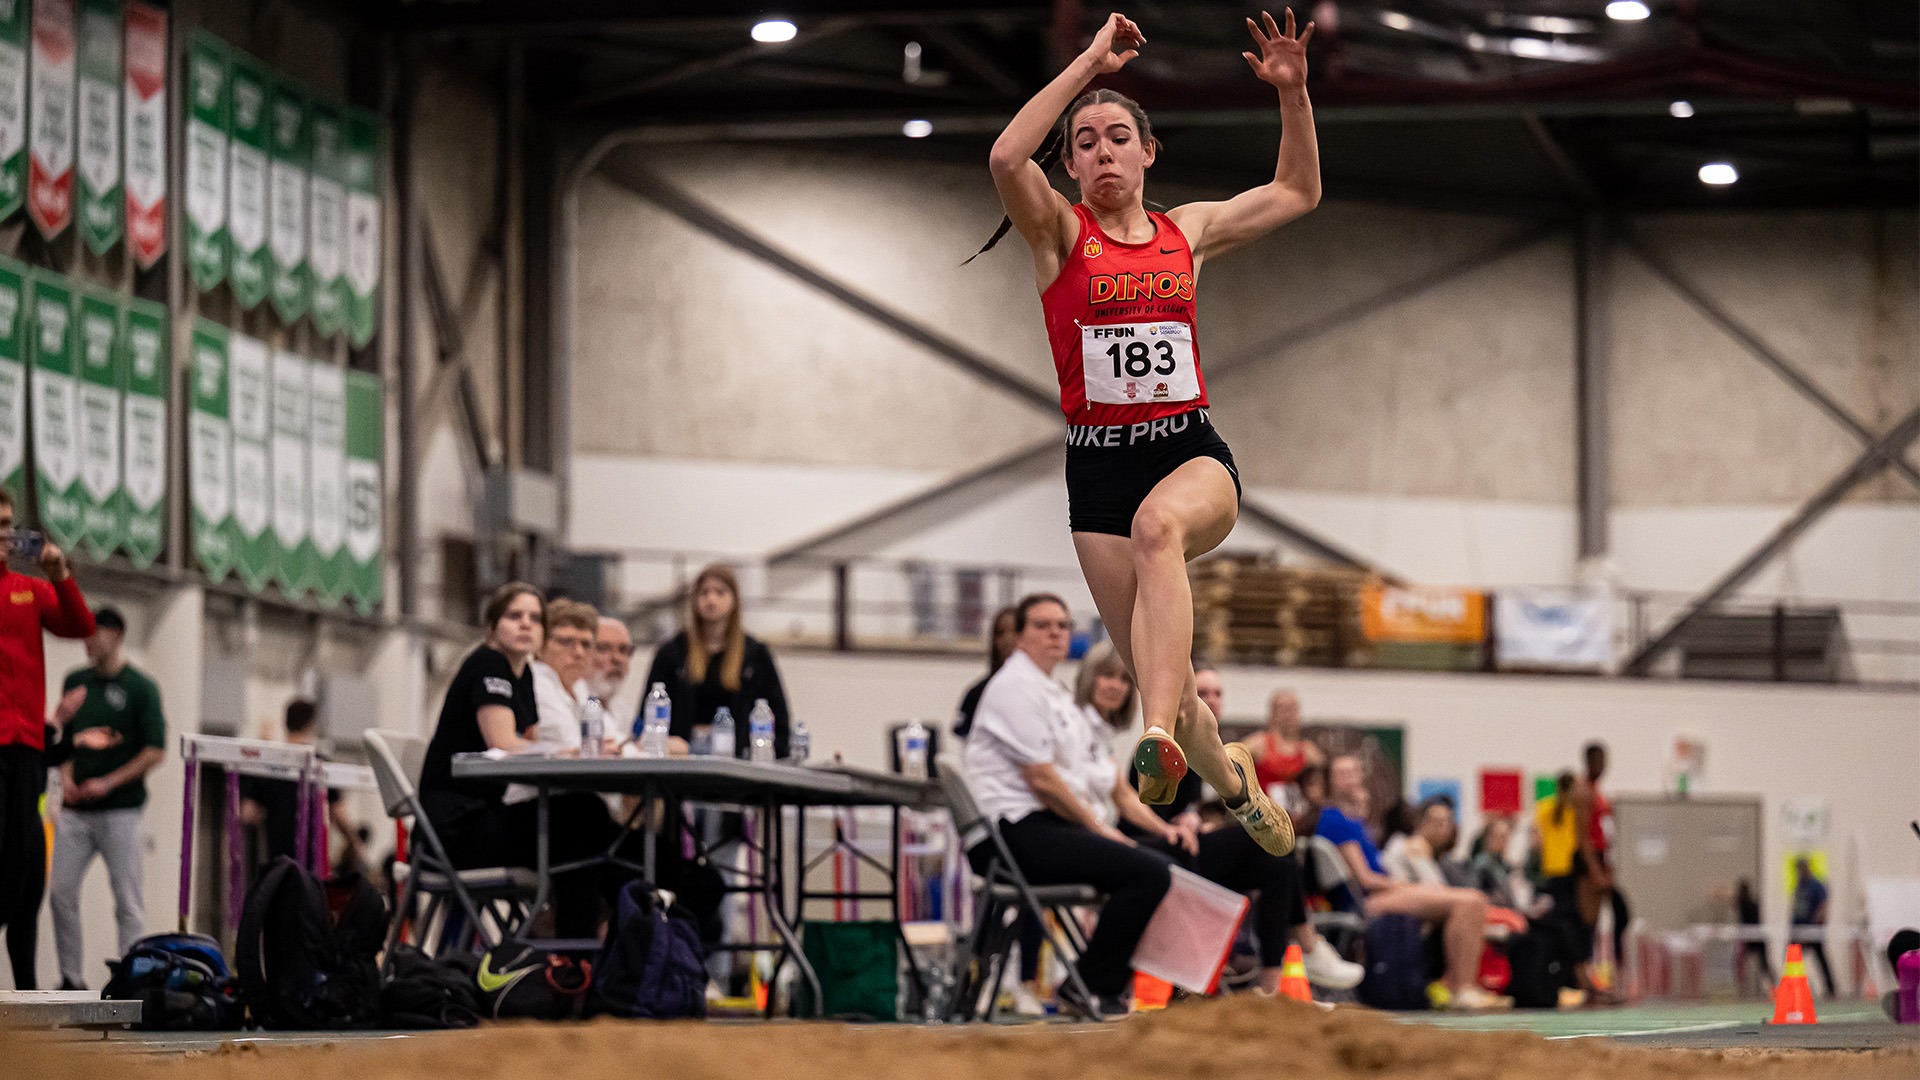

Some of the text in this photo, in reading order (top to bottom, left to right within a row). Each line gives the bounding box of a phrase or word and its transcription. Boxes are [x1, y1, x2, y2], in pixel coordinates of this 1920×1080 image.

[1085, 243, 1100, 255] CW
[1089, 270, 1194, 305] DINOS
[1095, 303, 1187, 319] UNIVERSITY OF CALGARY
[1094, 326, 1135, 339] FFUN
[1106, 340, 1176, 378] 183
[1065, 424, 1122, 447] NIKE
[1129, 412, 1189, 445] PRO
